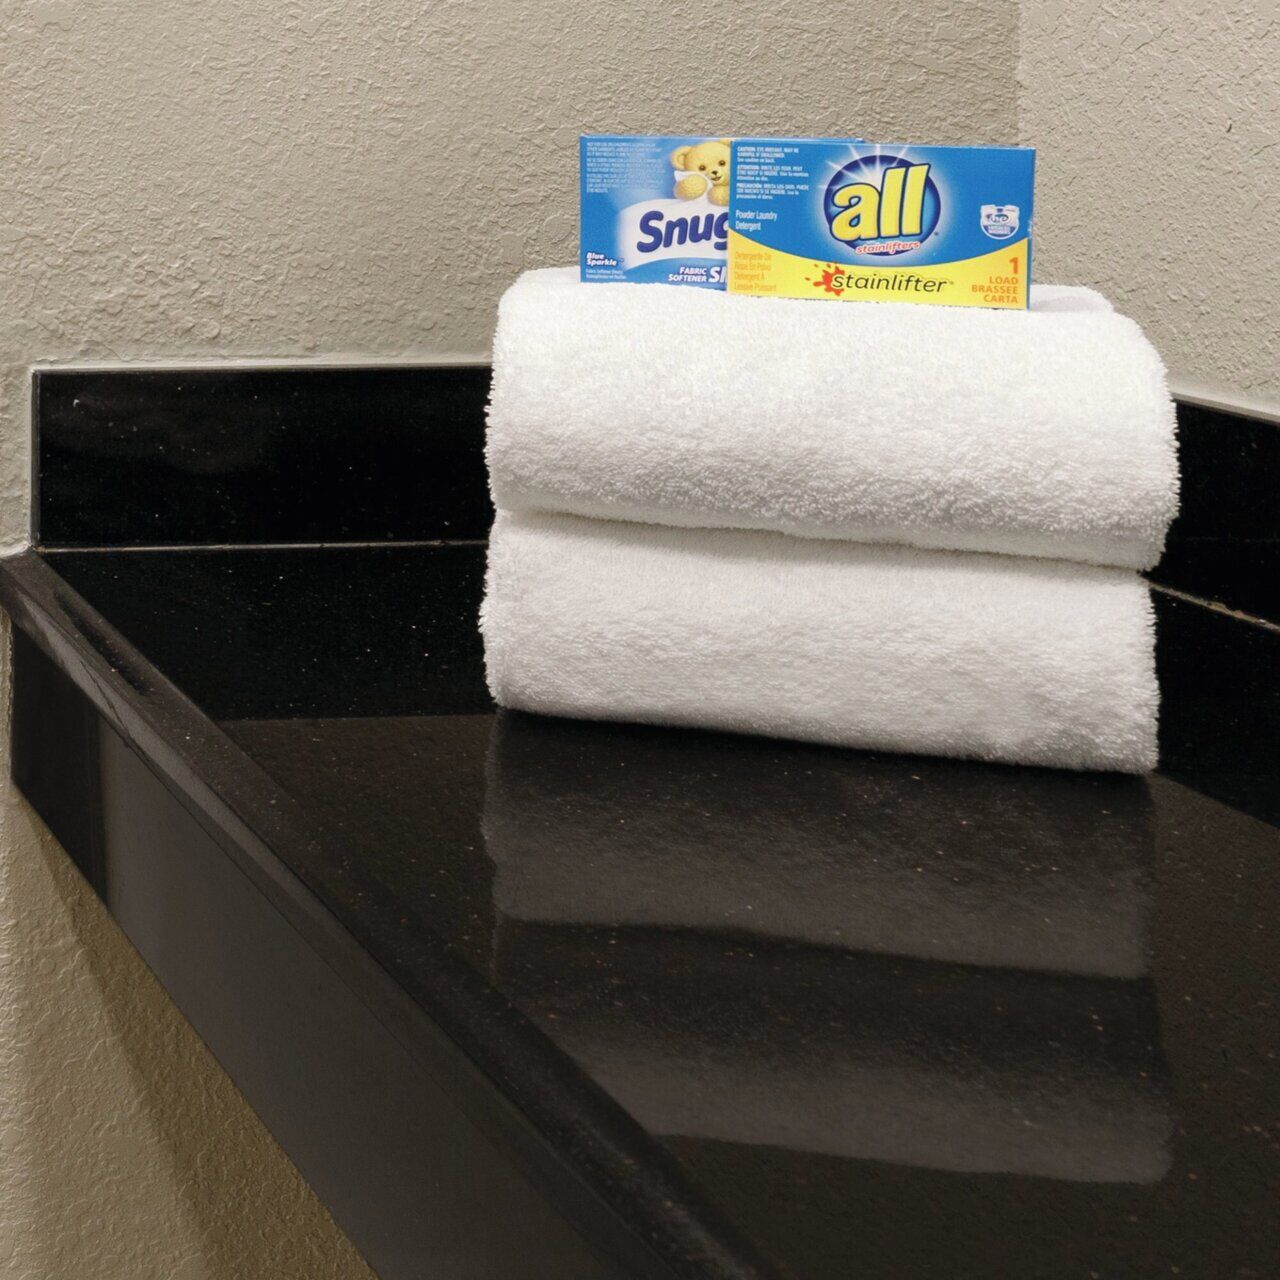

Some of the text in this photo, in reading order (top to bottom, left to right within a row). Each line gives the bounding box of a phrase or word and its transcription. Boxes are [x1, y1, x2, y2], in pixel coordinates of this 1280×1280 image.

[830, 163, 931, 242] all
[736, 210, 777, 222] Powder Laundry
[736, 221, 761, 231] Detergent
[856, 242, 920, 254] stainlifters
[1010, 257, 1018, 274] 1
[833, 274, 947, 292] stainlifter
[989, 276, 1018, 284] LOAD
[972, 285, 1018, 294] BRASSEE
[984, 295, 1018, 303] CARTA
